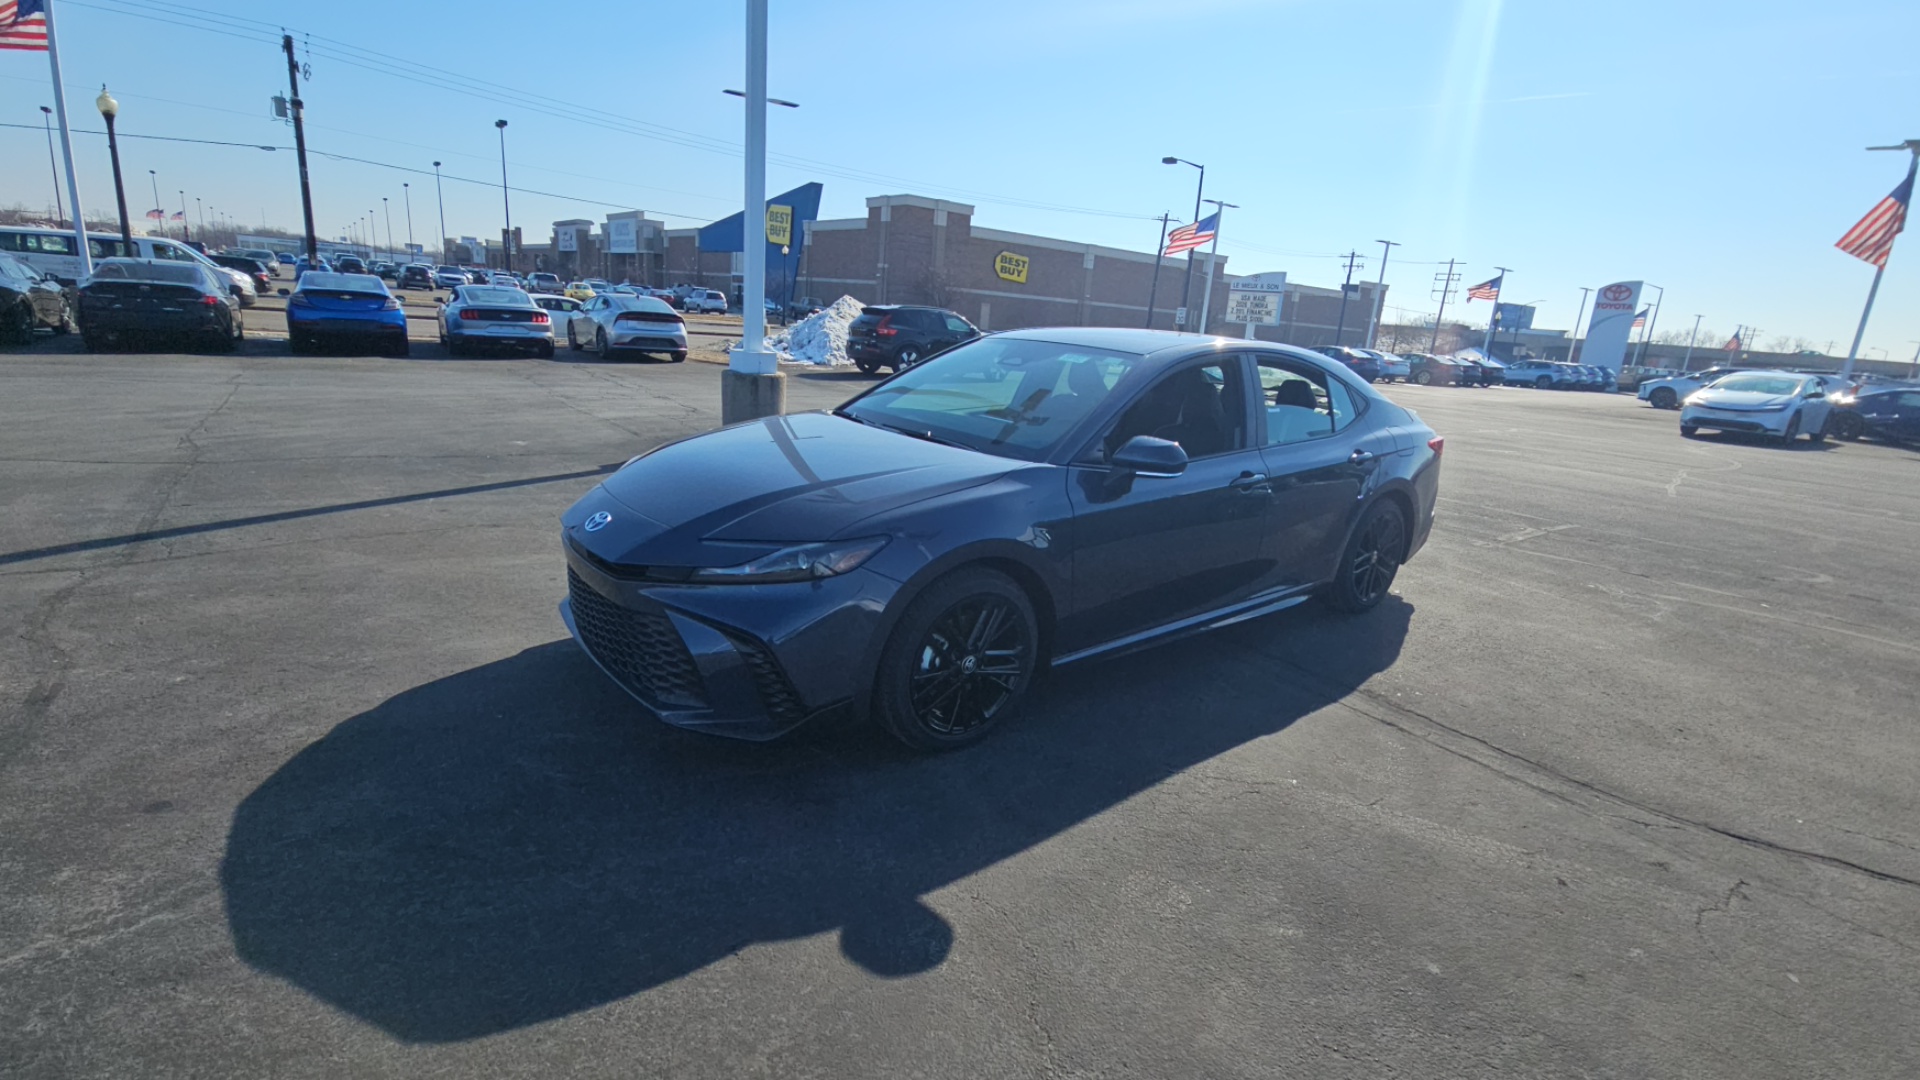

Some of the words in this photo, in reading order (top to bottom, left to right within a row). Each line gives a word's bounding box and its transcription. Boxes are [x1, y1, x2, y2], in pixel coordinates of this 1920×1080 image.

[768, 210, 791, 224] BEST
[769, 222, 788, 238] BUY
[999, 254, 1028, 270] BEST
[999, 265, 1024, 278] BUY
[1246, 308, 1272, 316] FINANCING
[1596, 302, 1633, 310] TOYOTA
